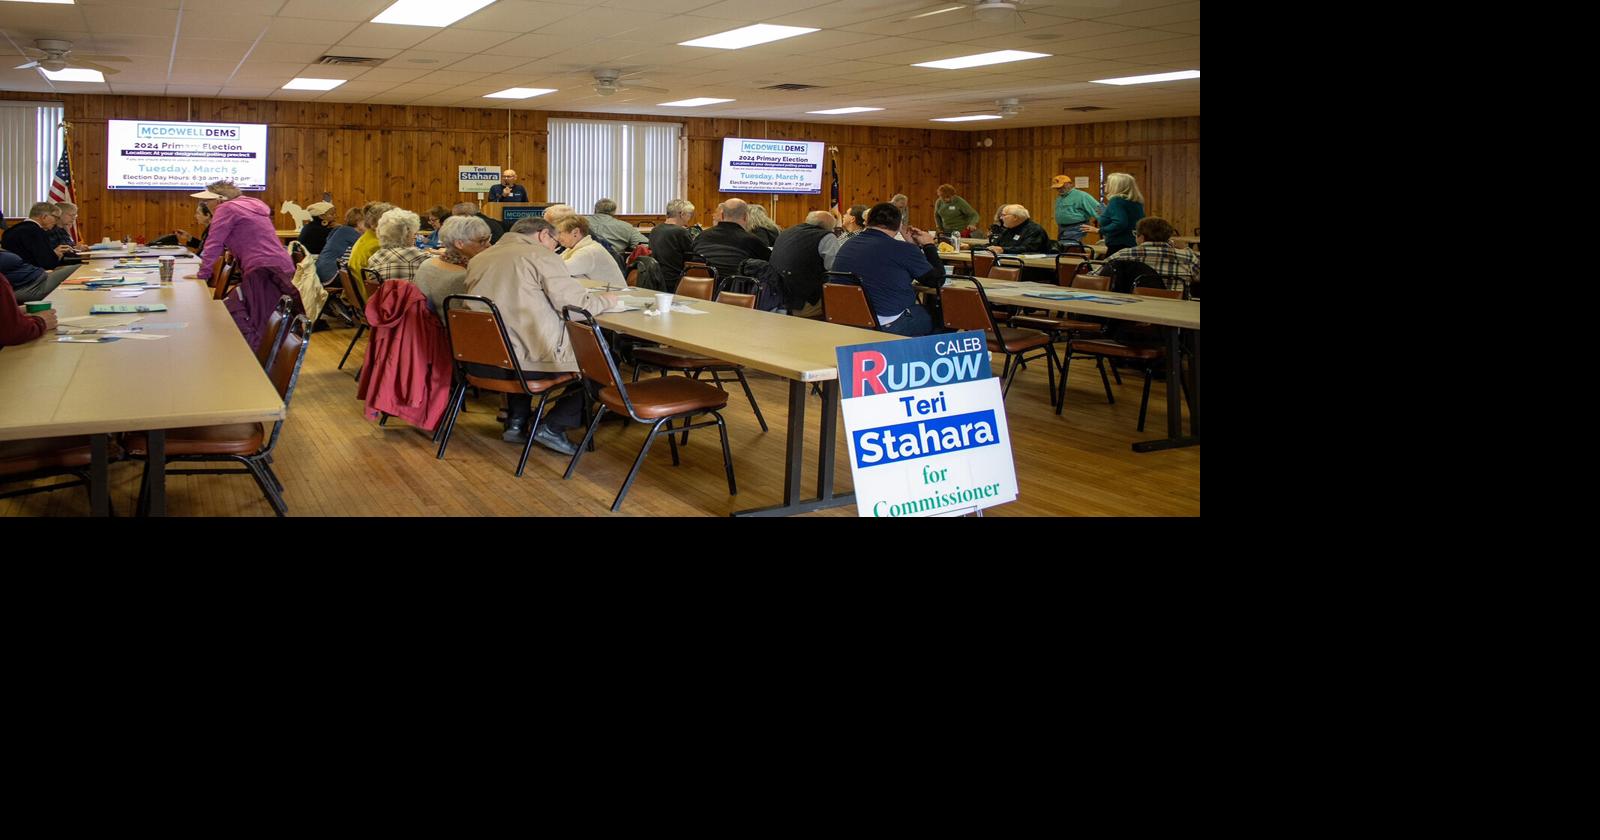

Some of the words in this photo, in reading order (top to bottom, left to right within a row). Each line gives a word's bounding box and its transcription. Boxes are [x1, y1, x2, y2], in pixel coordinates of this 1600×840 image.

[141, 127, 237, 137] MCDOWELLDEMS
[202, 143, 243, 151] Election
[744, 143, 805, 152] MCDOWELLDEMS
[756, 155, 781, 163] Primary
[193, 165, 228, 173] March
[935, 337, 982, 356] CALEB
[899, 391, 947, 417] Teri
[859, 420, 994, 463] Stahara
[922, 465, 948, 485] for
[873, 482, 1000, 517] Commissioner
